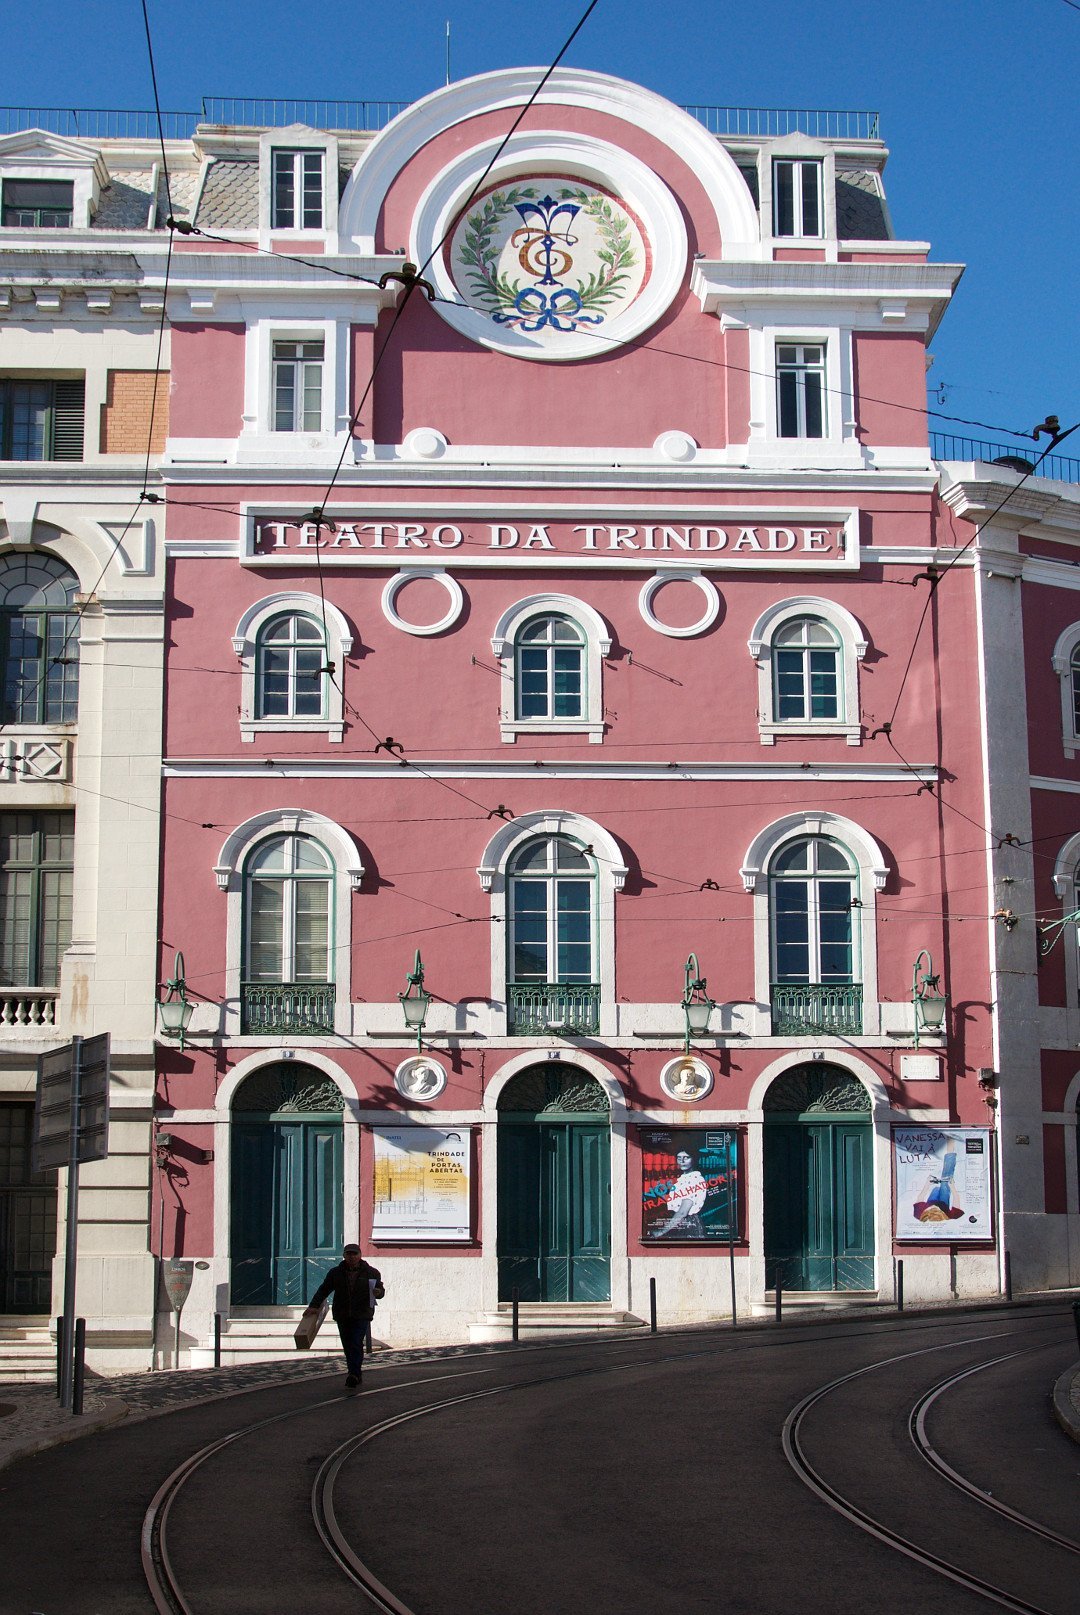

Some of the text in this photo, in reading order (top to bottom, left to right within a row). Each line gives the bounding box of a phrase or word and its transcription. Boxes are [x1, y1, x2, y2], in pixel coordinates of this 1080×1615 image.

[263, 523, 832, 552] TEATRO DA TRINDADE
[896, 1132, 946, 1144] VANESSA
[905, 1143, 923, 1152] VAI
[899, 1152, 932, 1164] LUTA
